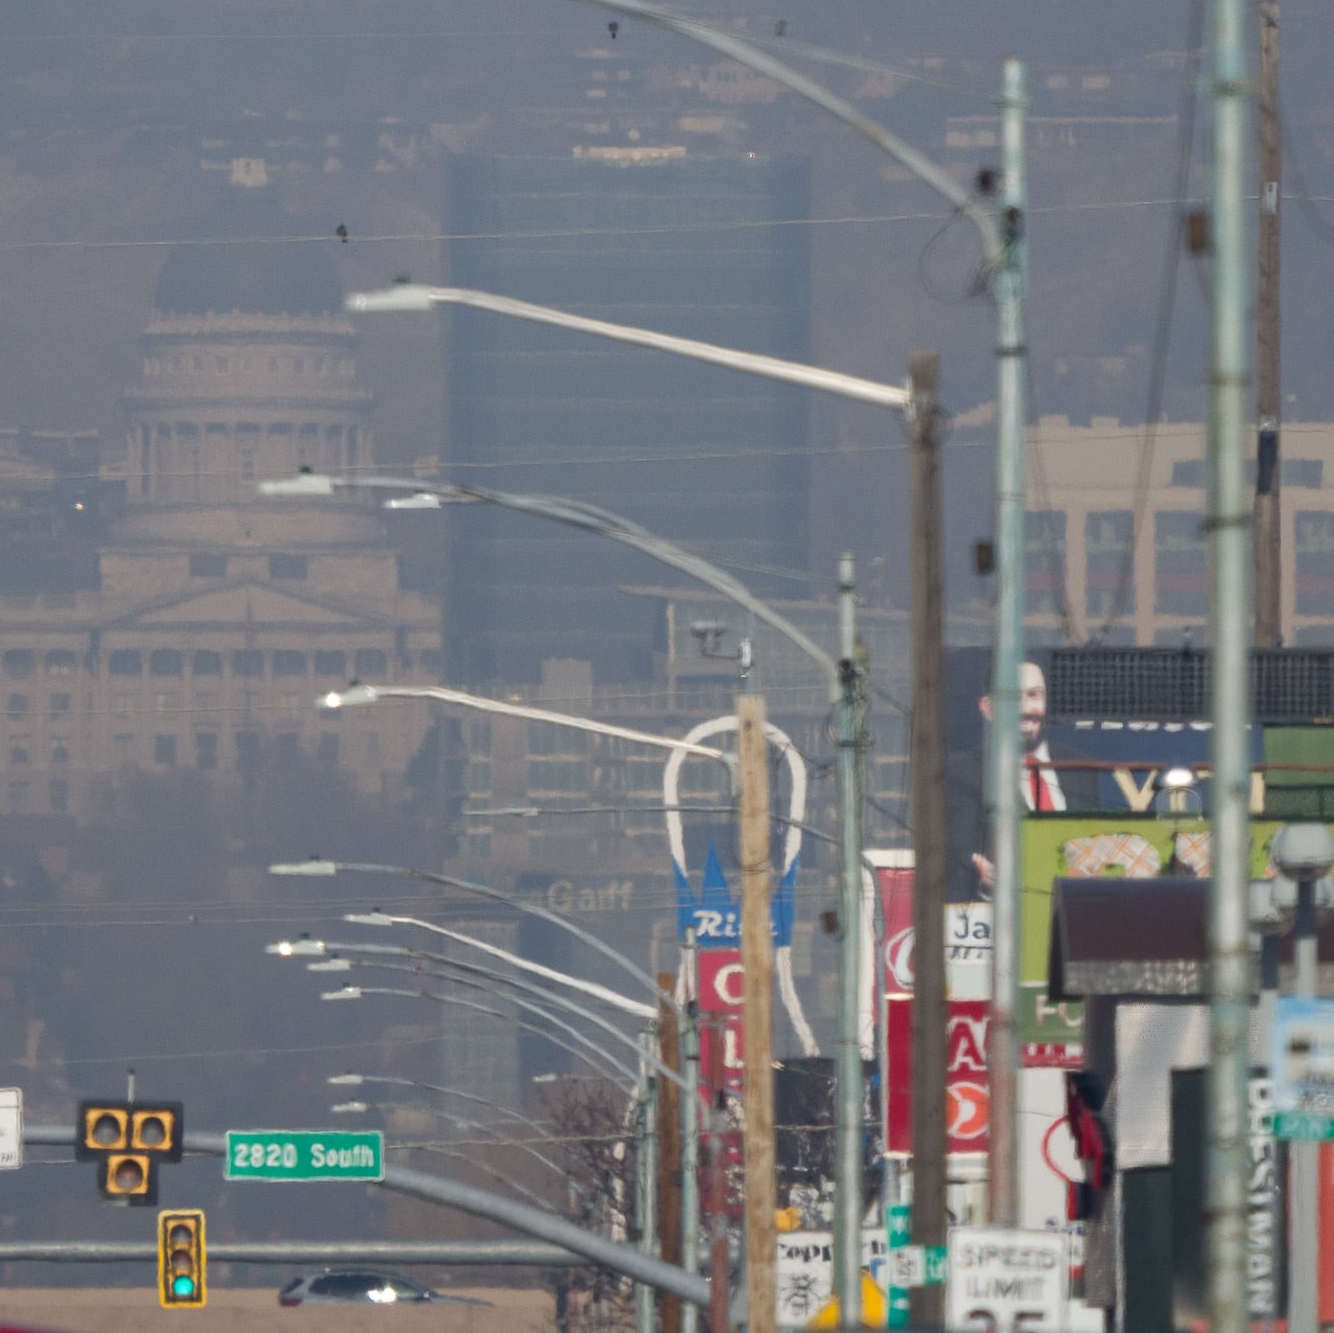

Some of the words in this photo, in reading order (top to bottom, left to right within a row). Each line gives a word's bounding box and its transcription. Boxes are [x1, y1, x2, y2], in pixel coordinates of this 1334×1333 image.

[234, 1143, 298, 1168] 2820
[310, 1142, 375, 1168] South
[959, 1244, 1055, 1269] SPEED
[966, 1277, 1045, 1299] LIMIT
